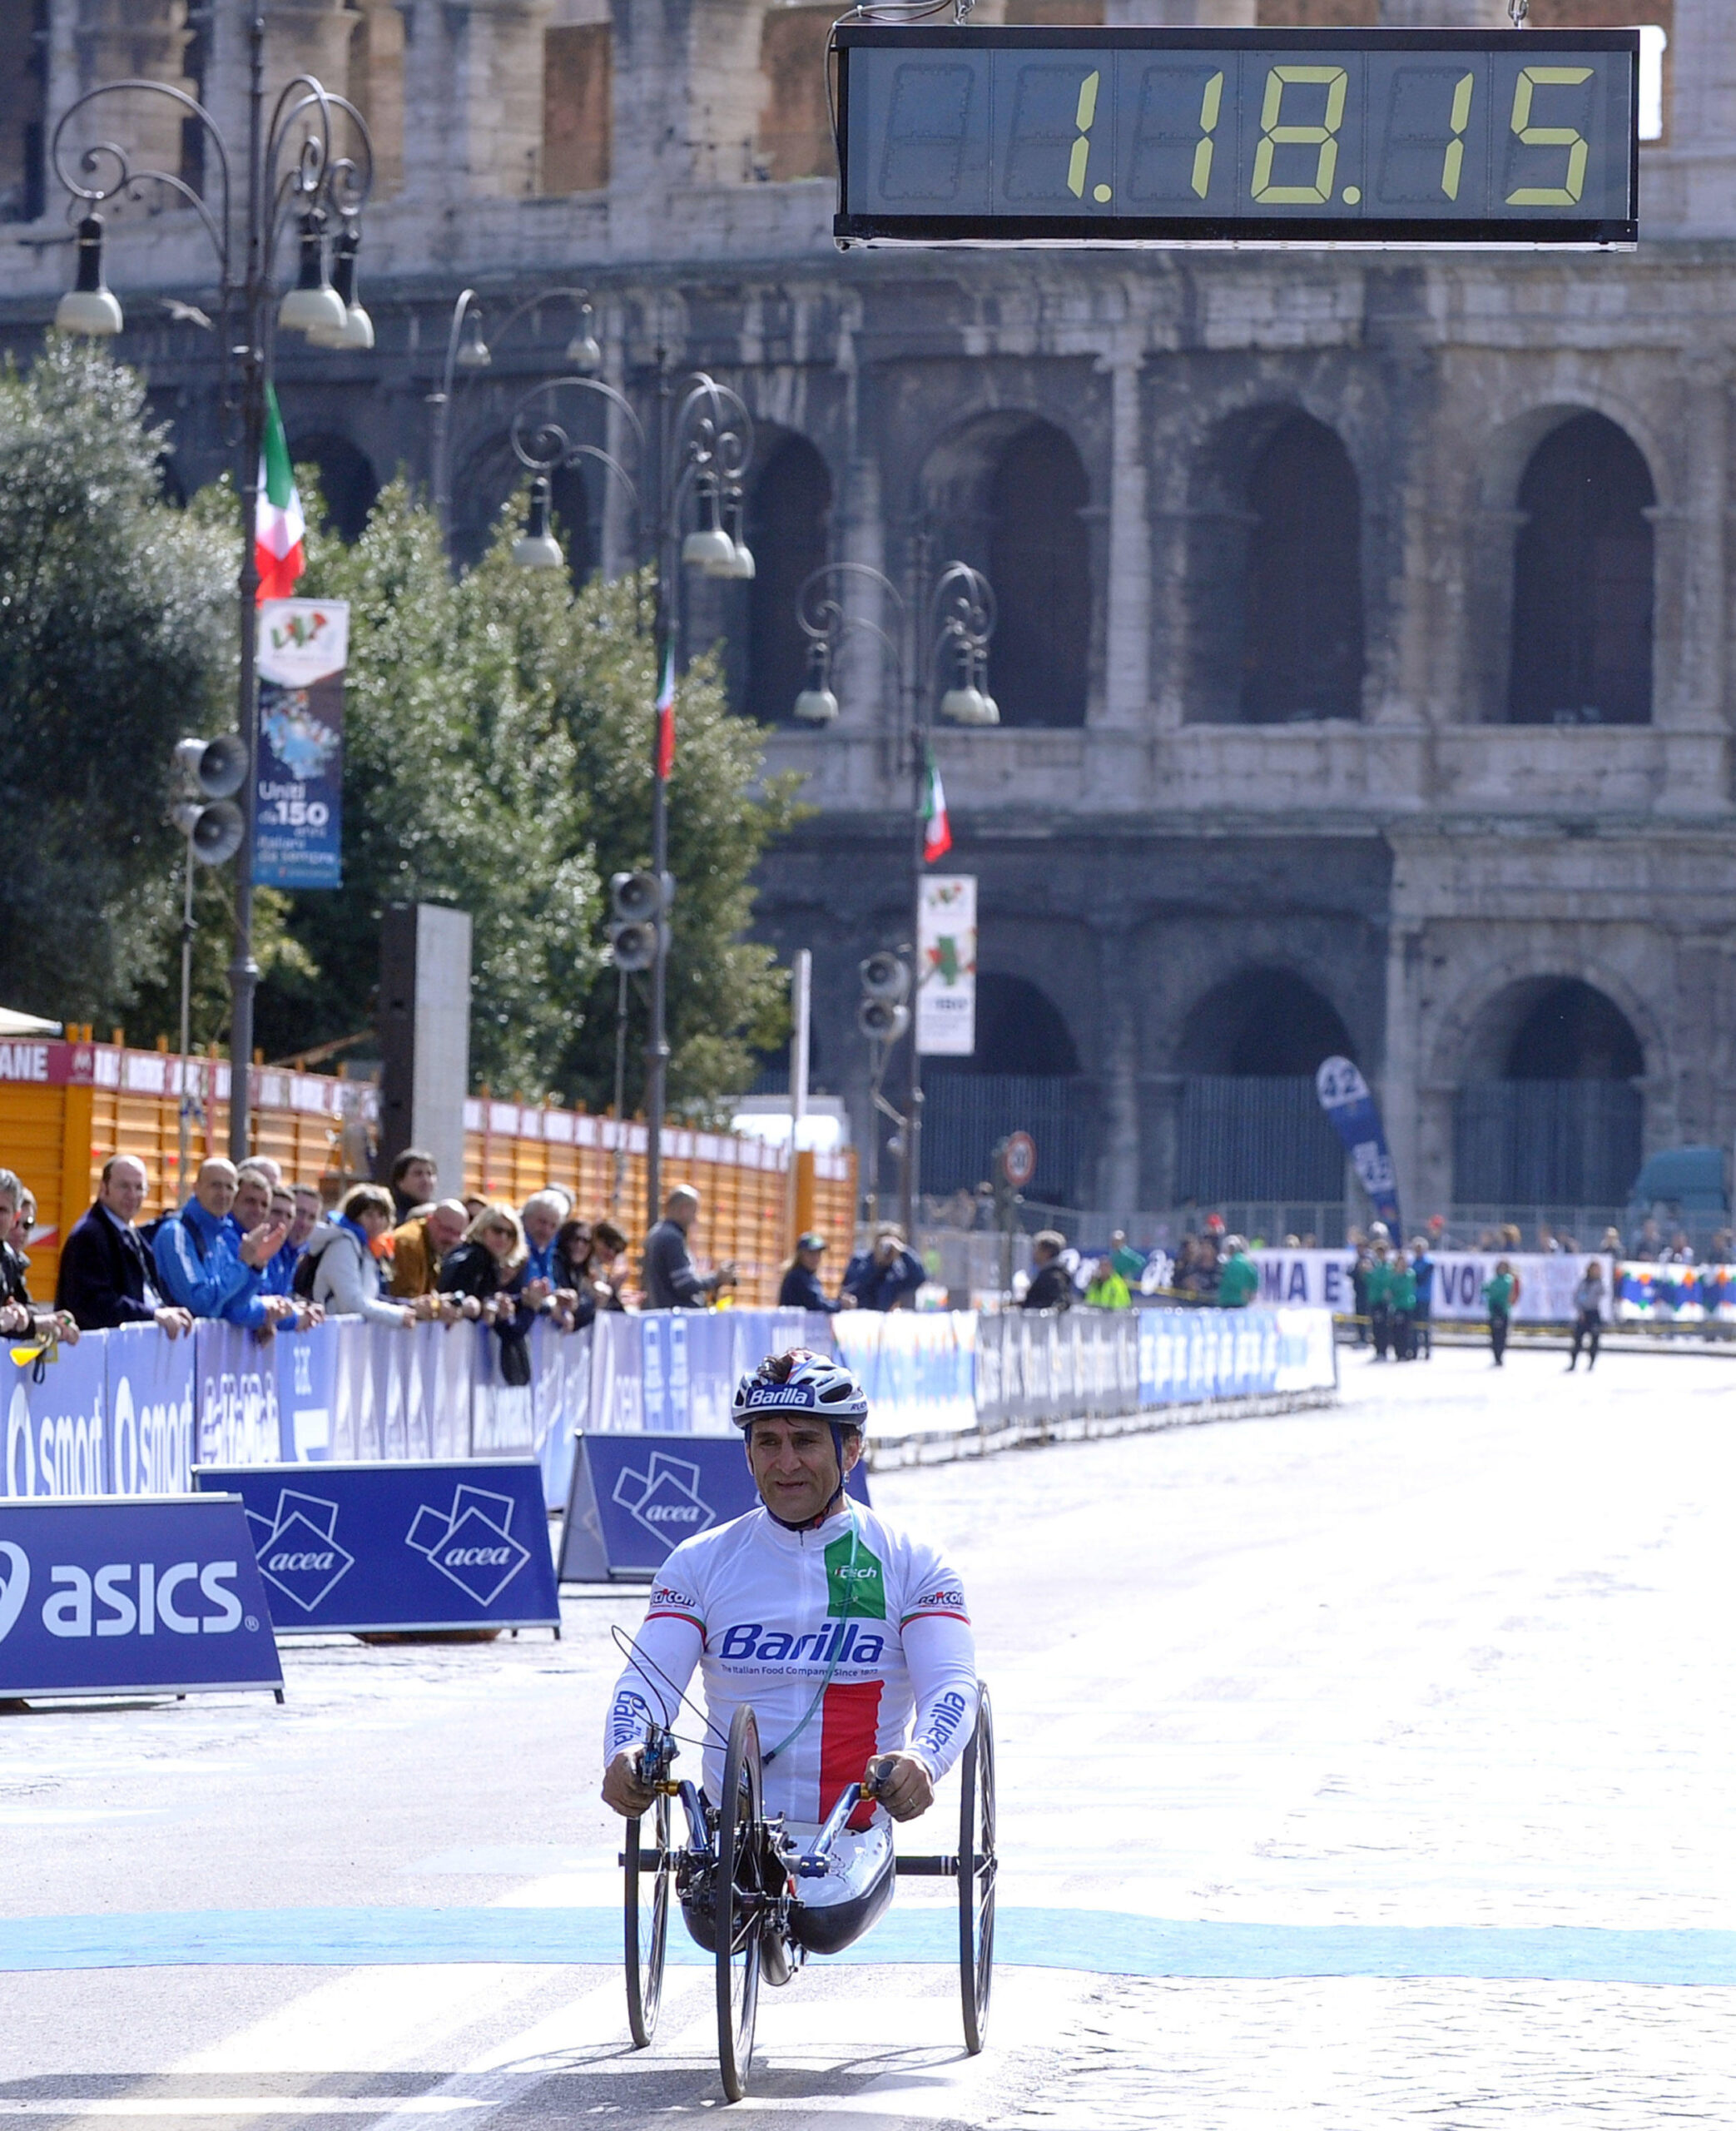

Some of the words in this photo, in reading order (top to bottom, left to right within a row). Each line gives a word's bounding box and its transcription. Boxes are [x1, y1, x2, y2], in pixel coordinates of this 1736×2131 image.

[275, 801, 329, 826] 150
[0, 1045, 47, 1080] ANE
[1257, 1261, 1307, 1302] MA
[750, 1388, 808, 1406] Barilla
[646, 1506, 700, 1523] acea
[269, 1550, 335, 1572] acea
[444, 1546, 510, 1567] acea
[718, 1623, 885, 1663] Barilla
[732, 1666, 760, 1674] Italian
[761, 1666, 784, 1675] Food
[834, 1668, 858, 1676] Since
[613, 1691, 646, 1747] Barilla
[916, 1691, 965, 1754] Barilla
